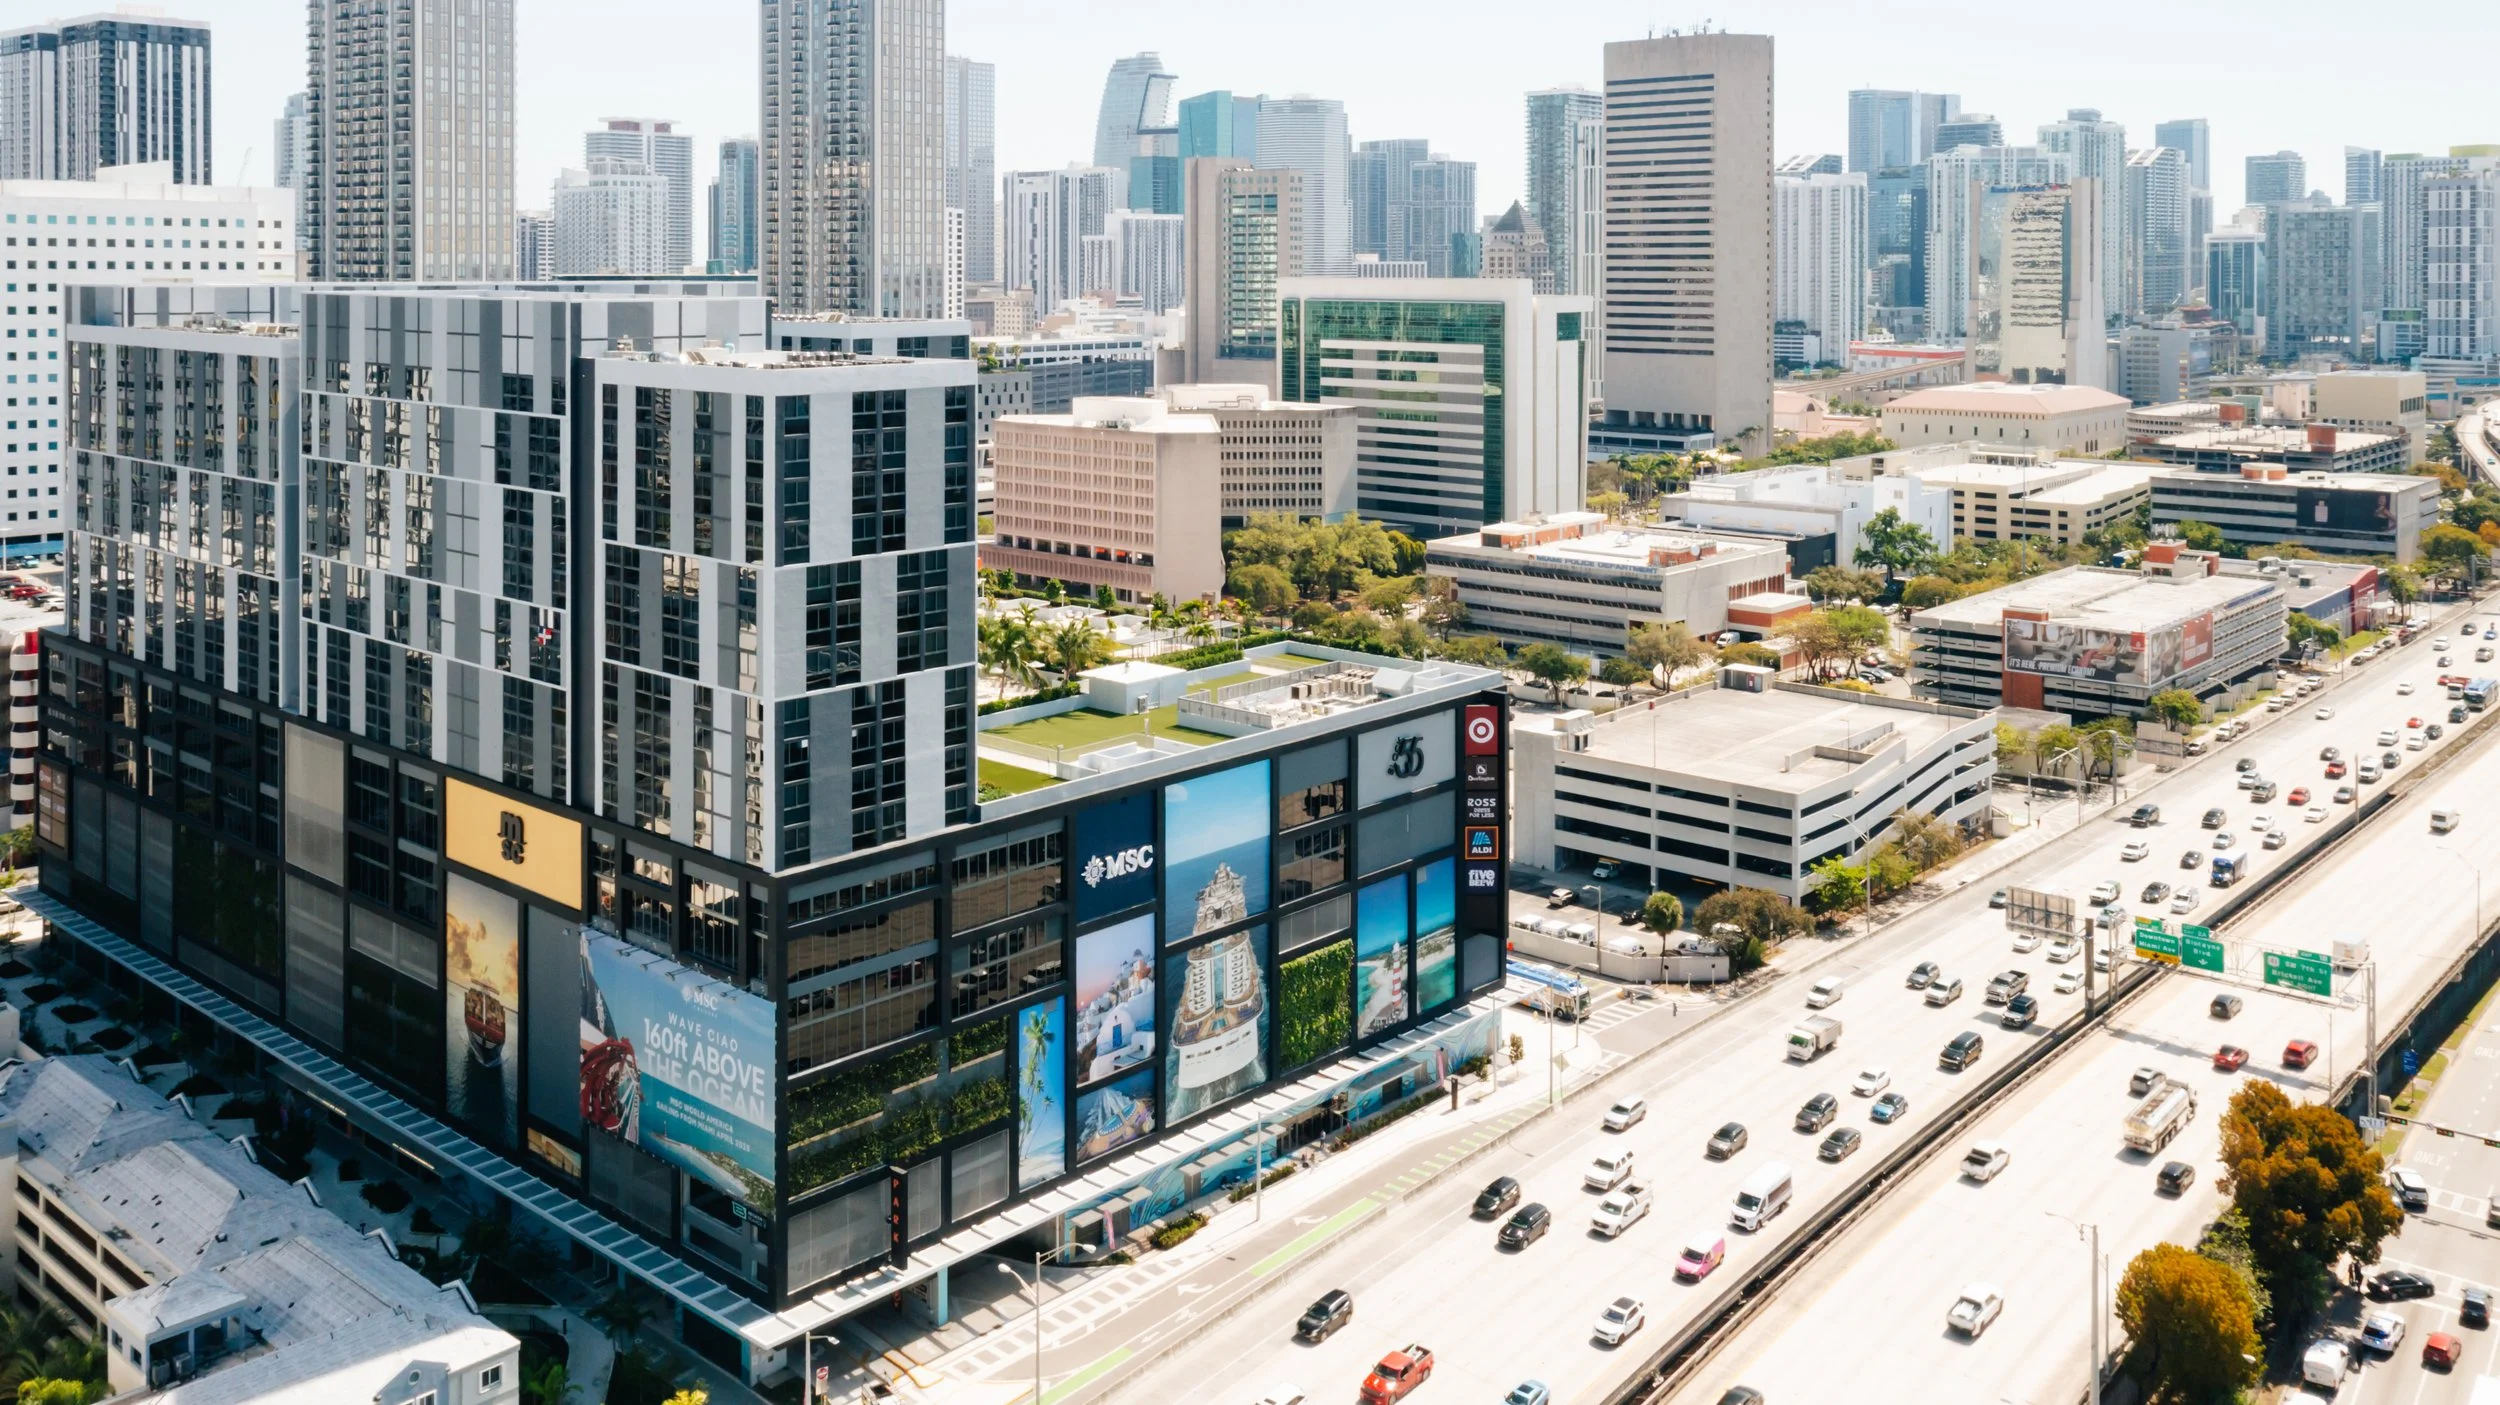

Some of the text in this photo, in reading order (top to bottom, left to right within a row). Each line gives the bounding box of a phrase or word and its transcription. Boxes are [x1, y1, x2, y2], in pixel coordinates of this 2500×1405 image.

[1536, 555, 1657, 574] MIAMI POLICE DEPARTMENT
[2009, 658, 2020, 667] IT'S
[2038, 661, 2067, 673] PREMIUM
[2068, 665, 2096, 676] ECONOMY
[1467, 798, 1496, 807] ROSS
[1105, 844, 1154, 880] MSC
[1468, 869, 1495, 880] five
[2138, 940, 2176, 953] Miami Ave
[2139, 932, 2176, 944] Downtown
[2185, 938, 2221, 951] Biscayne
[2193, 948, 2211, 957] Blvd
[2271, 969, 2304, 981] Brickell
[2300, 964, 2315, 973] 7th
[2319, 967, 2328, 975] St
[693, 990, 718, 1011] MSC
[668, 1012, 702, 1037] WAVE
[707, 1028, 739, 1052] CIAO
[643, 1017, 765, 1097] 160ft ABOVE
[643, 1047, 765, 1125] THE OCEAN
[656, 1100, 679, 1119] SAILING
[679, 1113, 697, 1126] FROM
[697, 1120, 716, 1137] MIAMI
[716, 1130, 734, 1145] APRIL
[683, 1103, 705, 1119] WORLD
[706, 1114, 733, 1133] AMERICA
[2414, 1150, 2444, 1166] ONLY
[892, 1178, 900, 1244] PARK
